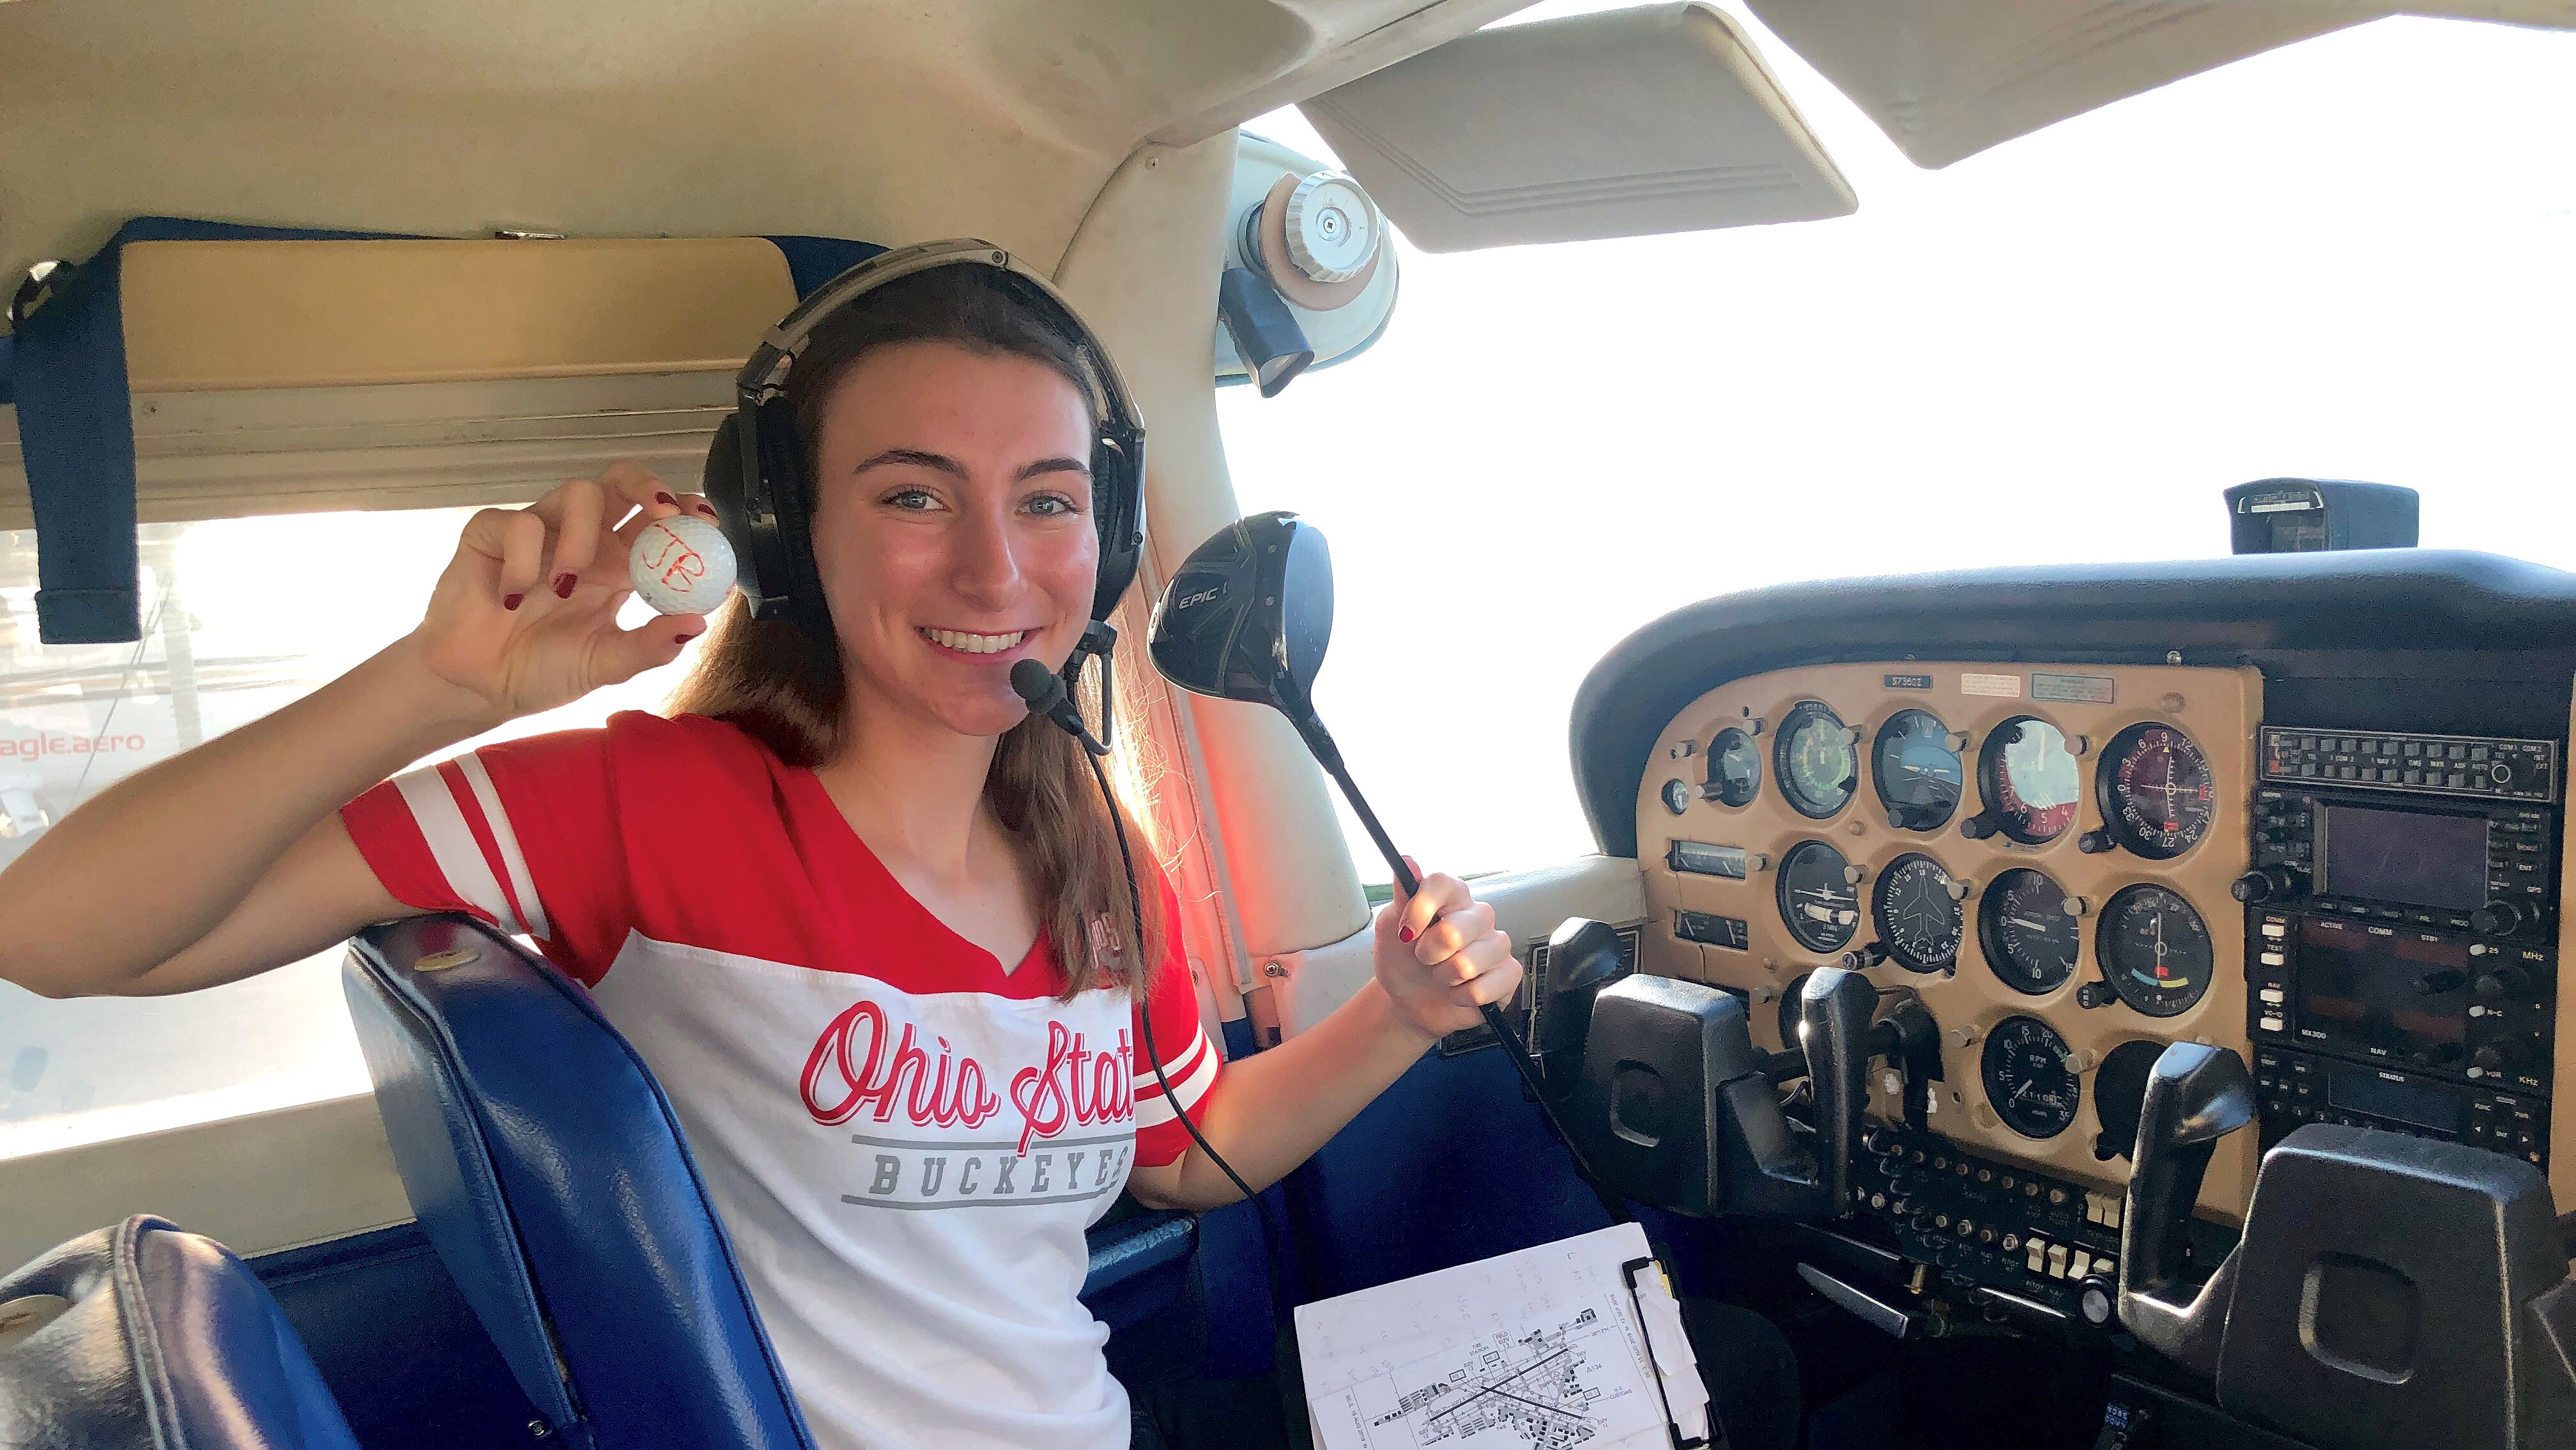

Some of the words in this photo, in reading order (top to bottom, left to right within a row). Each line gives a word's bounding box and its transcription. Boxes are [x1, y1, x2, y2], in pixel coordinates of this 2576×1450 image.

[1179, 588, 1218, 610] EPIC
[2161, 732, 2168, 743] 9
[2020, 803, 2027, 814] 6
[2061, 805, 2068, 816] 4
[2041, 812, 2048, 824] 5
[2161, 837, 2175, 848] 27
[2033, 874, 2043, 885] 10
[2000, 916, 2007, 926] 0
[2368, 926, 2393, 936] COMM
[2421, 934, 2438, 943] STBY
[2007, 943, 2014, 954] 5
[2522, 950, 2544, 961] MHz
[2032, 968, 2042, 979] 10
[2022, 1025, 2030, 1036] 15
[2371, 1047, 2387, 1056] NAV
[799, 1000, 1001, 1129] Ohio
[2029, 1054, 2048, 1065] RPM
[1999, 1071, 2005, 1081] 5
[2519, 1076, 2539, 1086] KHz
[2009, 1099, 2015, 1108] 0
[869, 1145, 1129, 1197] BUCKEYES
[1615, 1307, 1624, 1317] SEP
[1469, 1346, 1489, 1356] STATION
[1633, 1345, 1642, 1356] AUG
[1609, 1389, 1632, 1400] CUSTOMS
[1353, 1417, 1361, 1429] AUG
[1358, 1429, 1366, 1442] 2019
